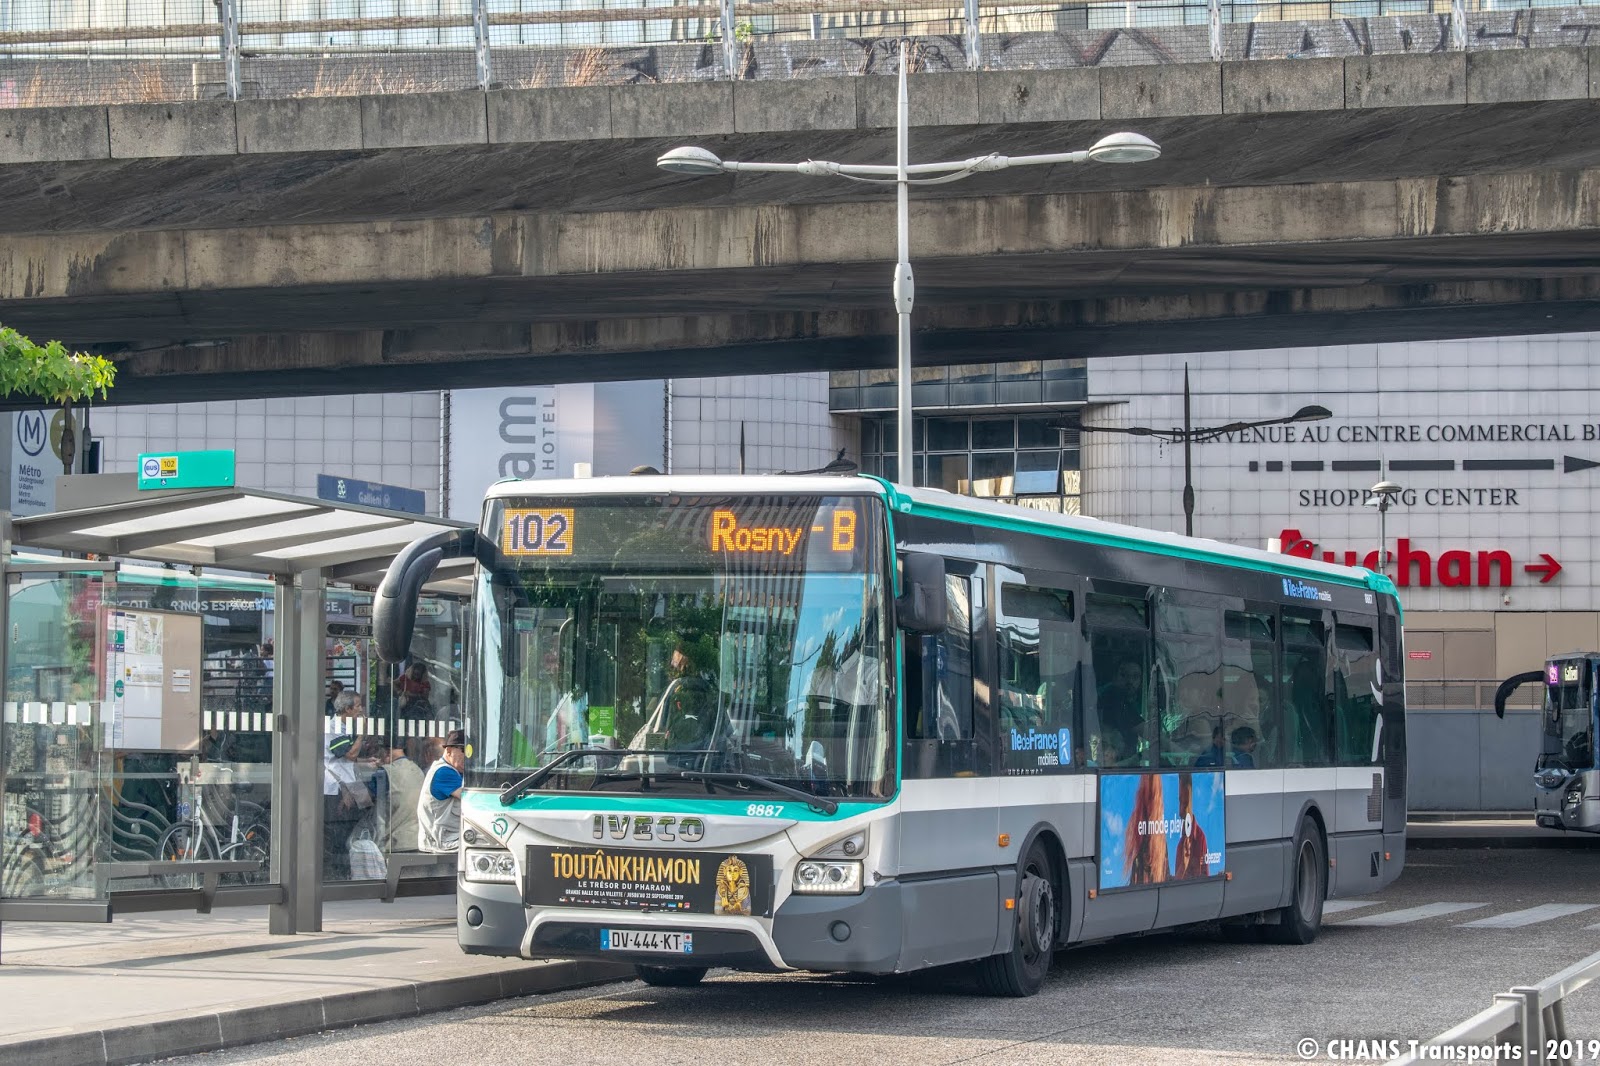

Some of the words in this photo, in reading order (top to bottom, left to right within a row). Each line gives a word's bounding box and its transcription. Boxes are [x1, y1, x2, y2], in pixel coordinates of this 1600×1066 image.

[542, 399, 555, 470] HOTEL
[1171, 426, 1295, 443] BENVENUE
[1301, 426, 1330, 442] AU
[1337, 425, 1421, 442] CENTRE
[1427, 424, 1576, 442] COMMERCIAL
[1582, 424, 1600, 441] B
[19, 464, 41, 478] Métro
[163, 460, 175, 468] 102
[1425, 488, 1520, 506] CENTER
[508, 513, 567, 550] 102
[712, 510, 802, 555] Rosny
[832, 509, 856, 551] B
[1037, 752, 1059, 766] mobilités
[747, 803, 784, 817] 8887
[592, 813, 704, 843] IVECO
[1138, 820, 1147, 835] en
[1148, 814, 1168, 835] mode
[1170, 813, 1185, 839] play
[551, 849, 700, 885] TOUTÂNKHAMON
[590, 881, 619, 889] TRÉSOR
[621, 882, 632, 890] DU
[635, 883, 671, 891] PHARAON
[612, 932, 681, 950] DV-444-KT
[684, 943, 692, 952] 75
